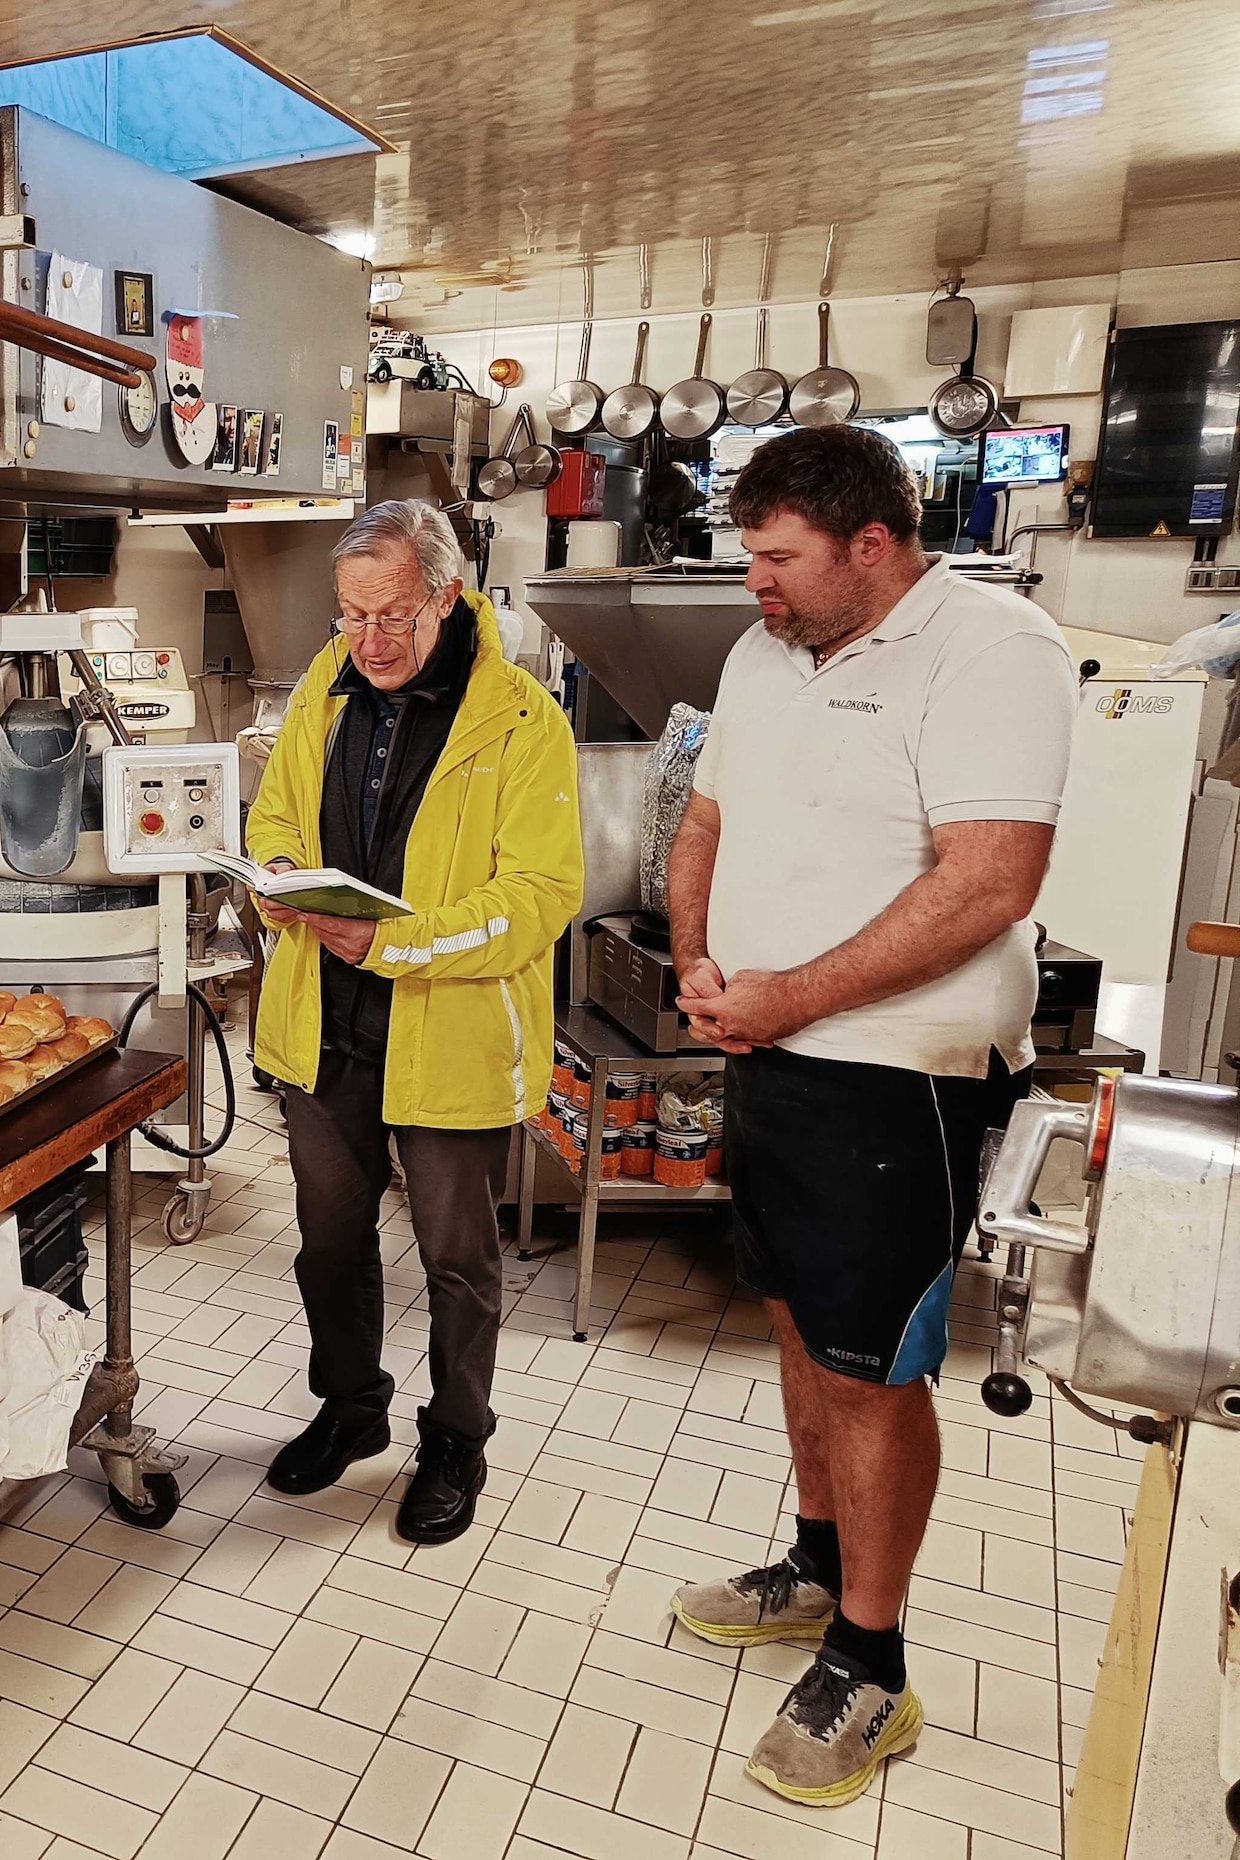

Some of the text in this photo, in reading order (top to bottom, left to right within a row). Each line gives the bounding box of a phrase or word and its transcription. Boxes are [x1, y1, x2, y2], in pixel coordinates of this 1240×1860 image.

[117, 705, 168, 715] KEMPER
[827, 699, 879, 714] WALDKORN
[1096, 695, 1175, 714] OOMS
[861, 1698, 895, 1750] HOKA
